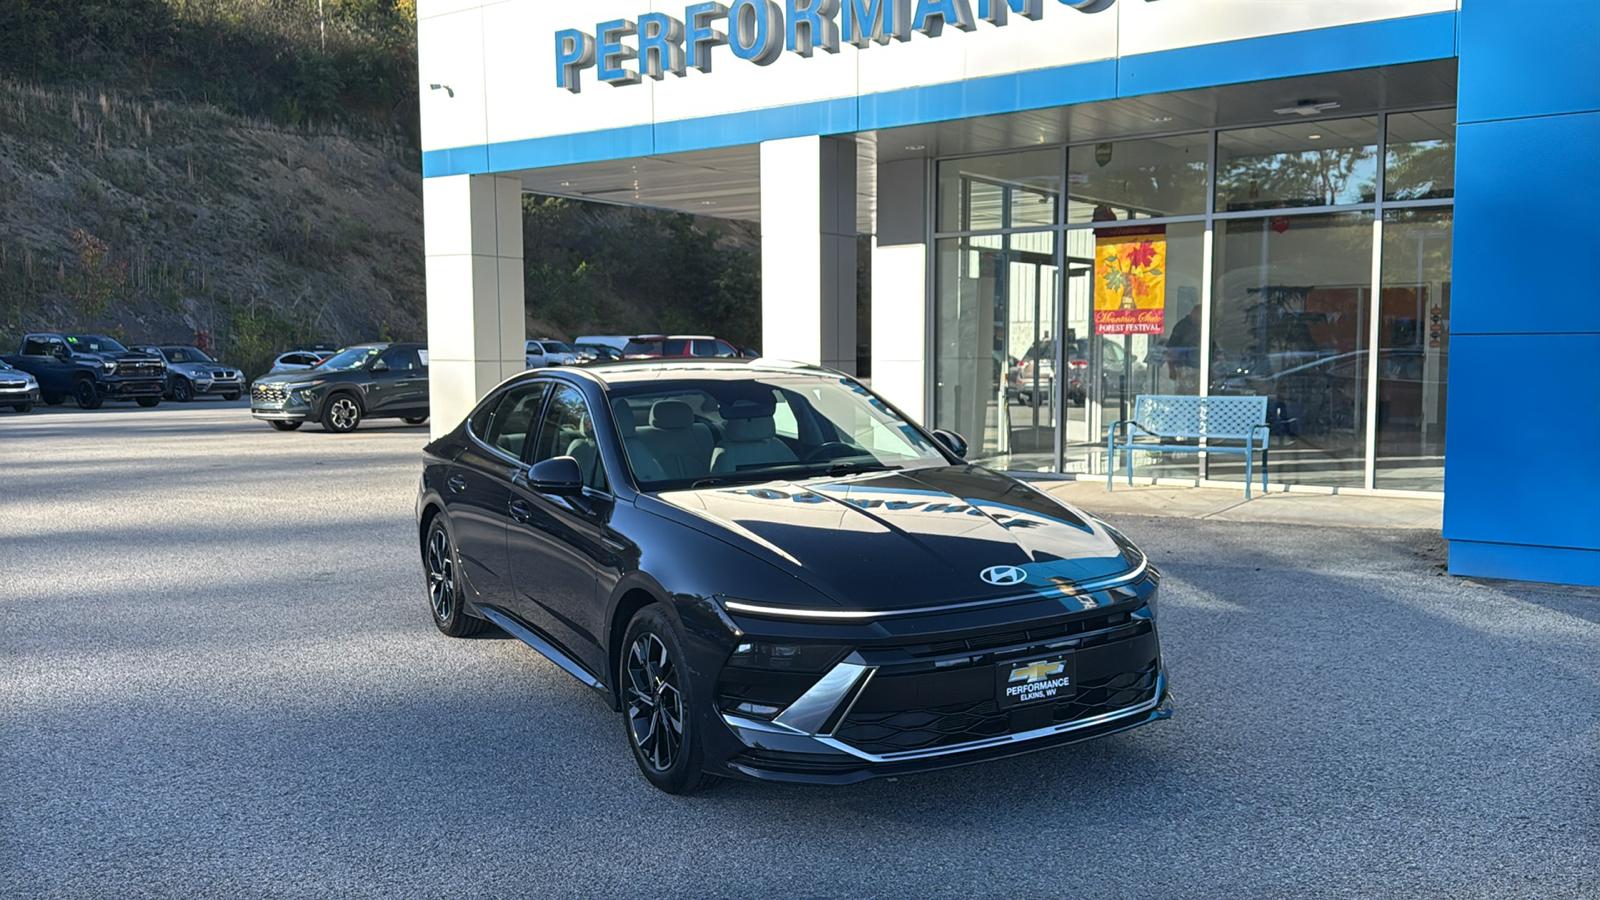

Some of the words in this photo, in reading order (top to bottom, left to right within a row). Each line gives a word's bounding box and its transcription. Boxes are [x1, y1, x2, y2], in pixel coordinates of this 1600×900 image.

[1098, 323, 1125, 332] FOREST
[1125, 323, 1161, 332] FESTIVAL
[1006, 677, 1069, 696] PERFORMANCE
[1020, 691, 1045, 701] ELKINS,
[1046, 688, 1057, 696] WV
